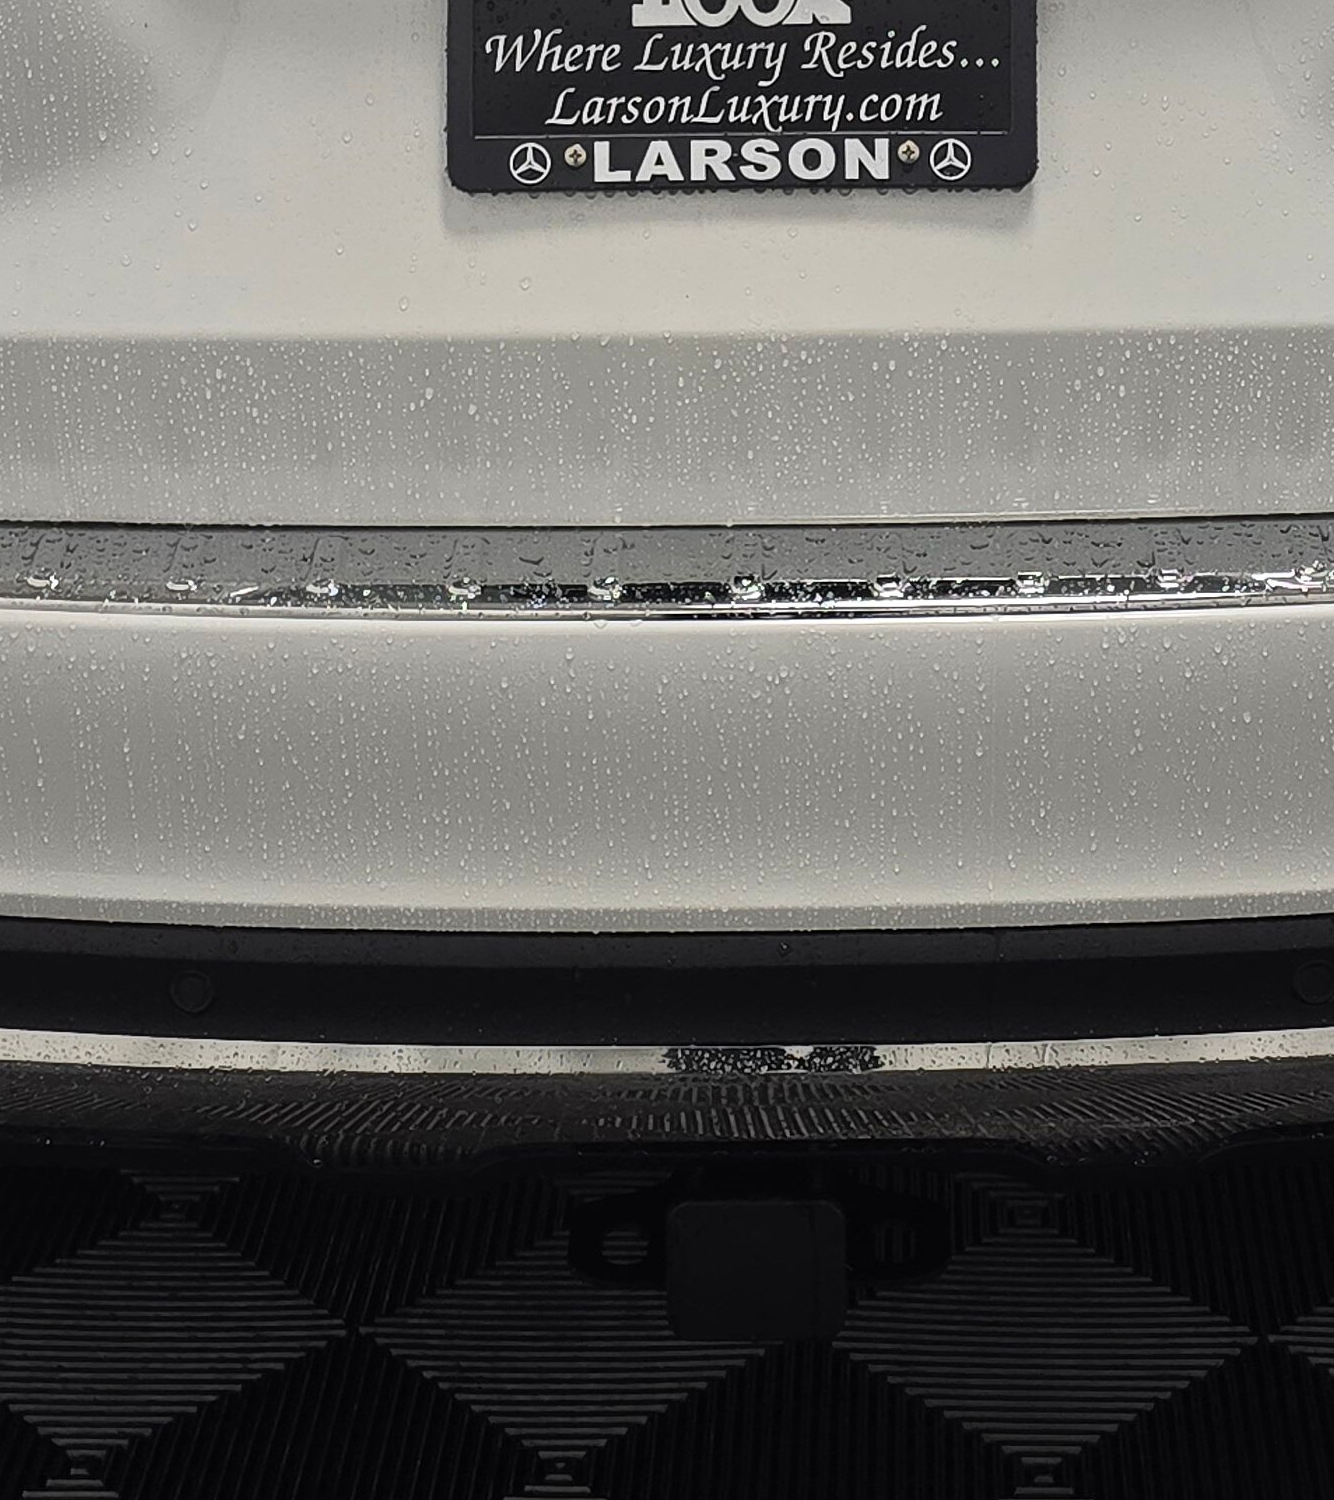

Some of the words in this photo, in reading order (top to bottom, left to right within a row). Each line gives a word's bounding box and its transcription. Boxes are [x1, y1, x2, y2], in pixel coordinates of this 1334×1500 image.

[484, 28, 622, 74] Where
[633, 31, 788, 87] Luxury
[798, 24, 1000, 75] Resides...
[545, 84, 944, 133] LarsonLuxury.com
[593, 137, 891, 183] LARSON
